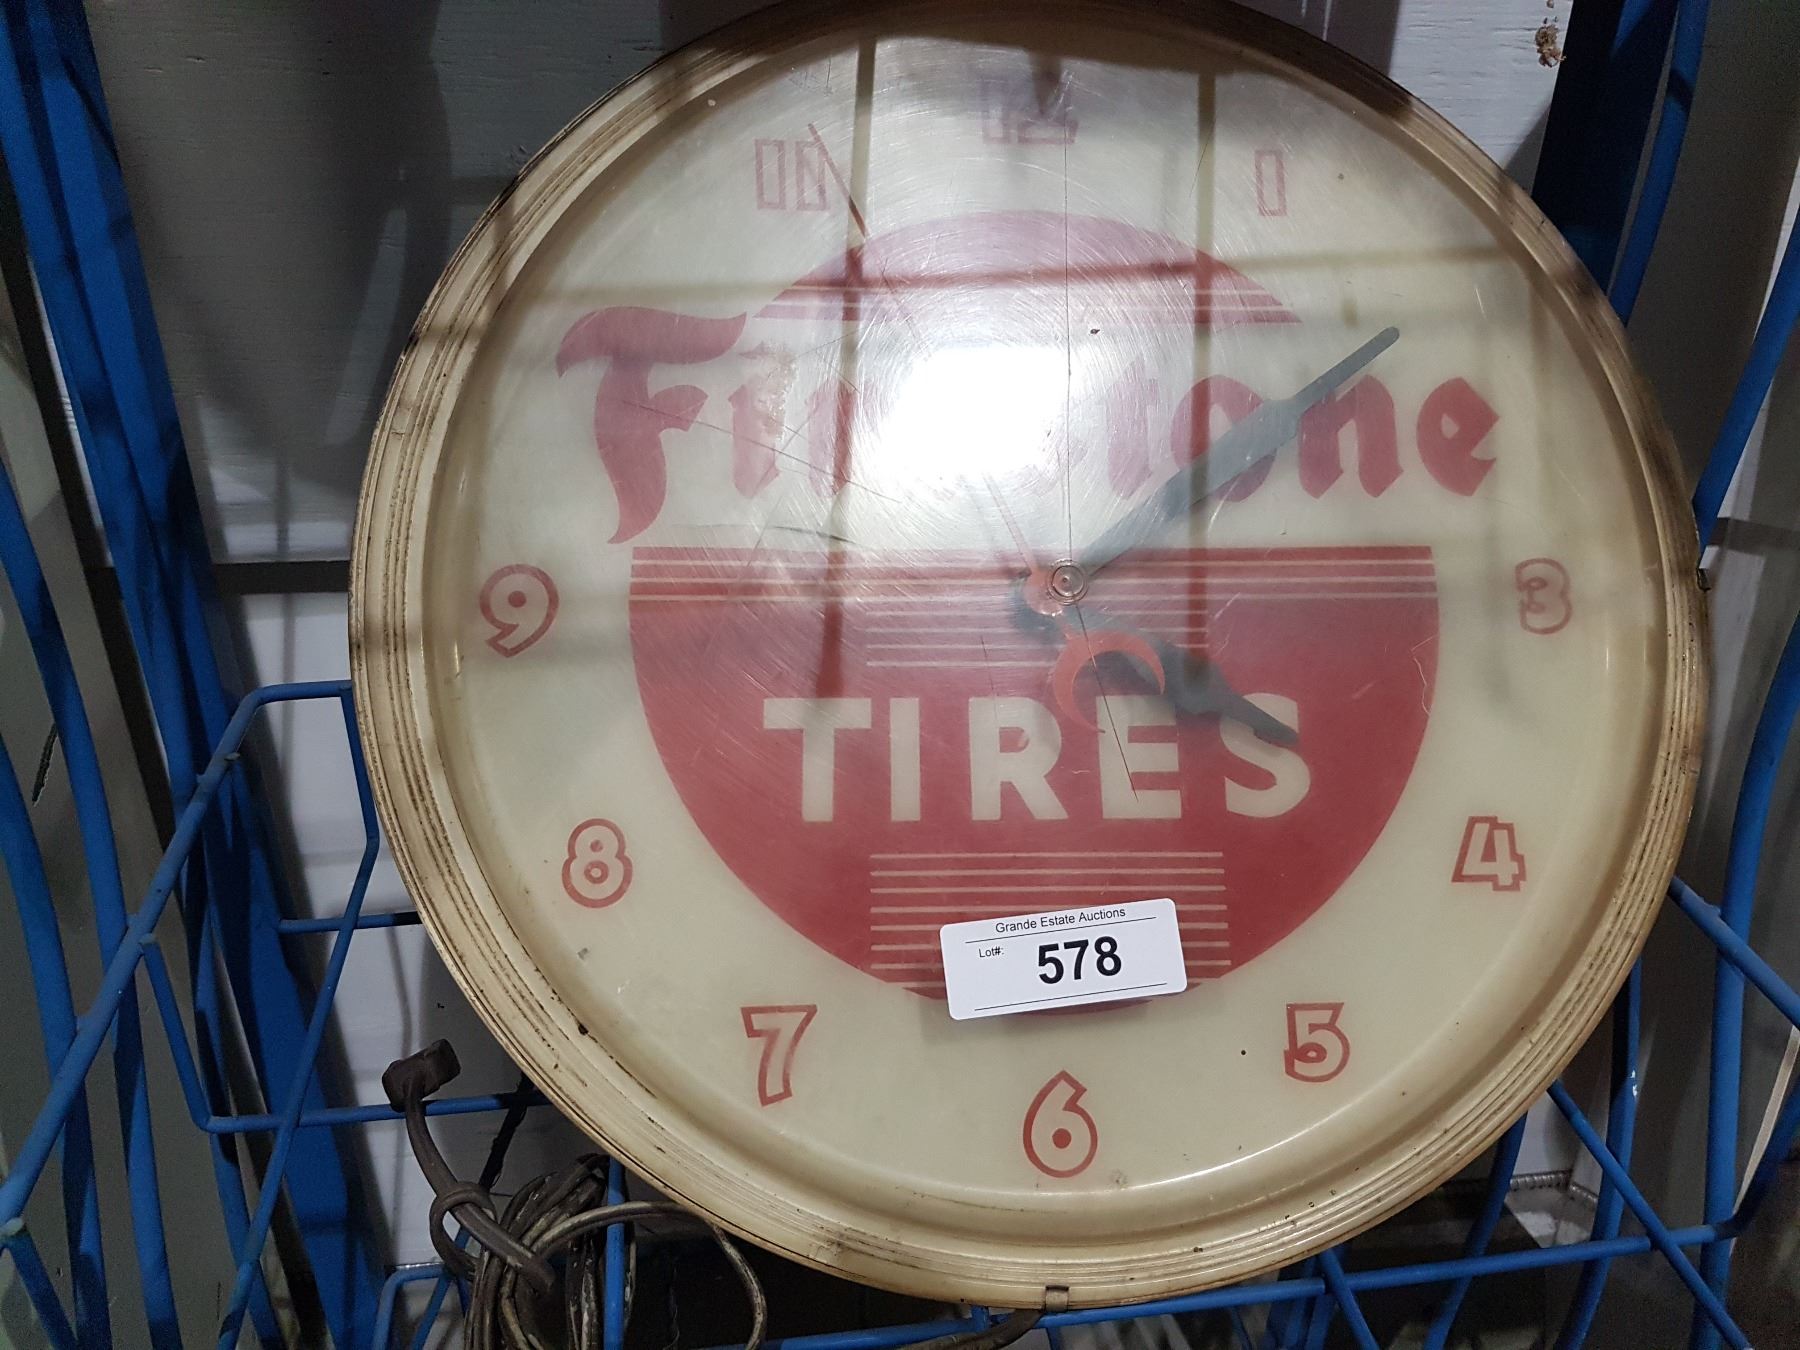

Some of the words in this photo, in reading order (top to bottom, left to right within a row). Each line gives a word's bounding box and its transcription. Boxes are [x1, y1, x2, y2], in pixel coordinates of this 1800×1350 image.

[479, 563, 559, 657] 9
[1515, 557, 1573, 634] 3
[762, 692, 1312, 825] TIRES
[561, 818, 632, 908] 8
[1451, 815, 1527, 892] 4
[978, 945, 1005, 958] Lot#:
[1037, 935, 1122, 985] 578
[995, 919, 1037, 933] Grande
[1040, 915, 1076, 928] Estate
[1078, 907, 1126, 922] Auctions
[740, 1004, 818, 1106] 7
[1283, 1002, 1350, 1083] 5
[1022, 1070, 1099, 1179] 6
